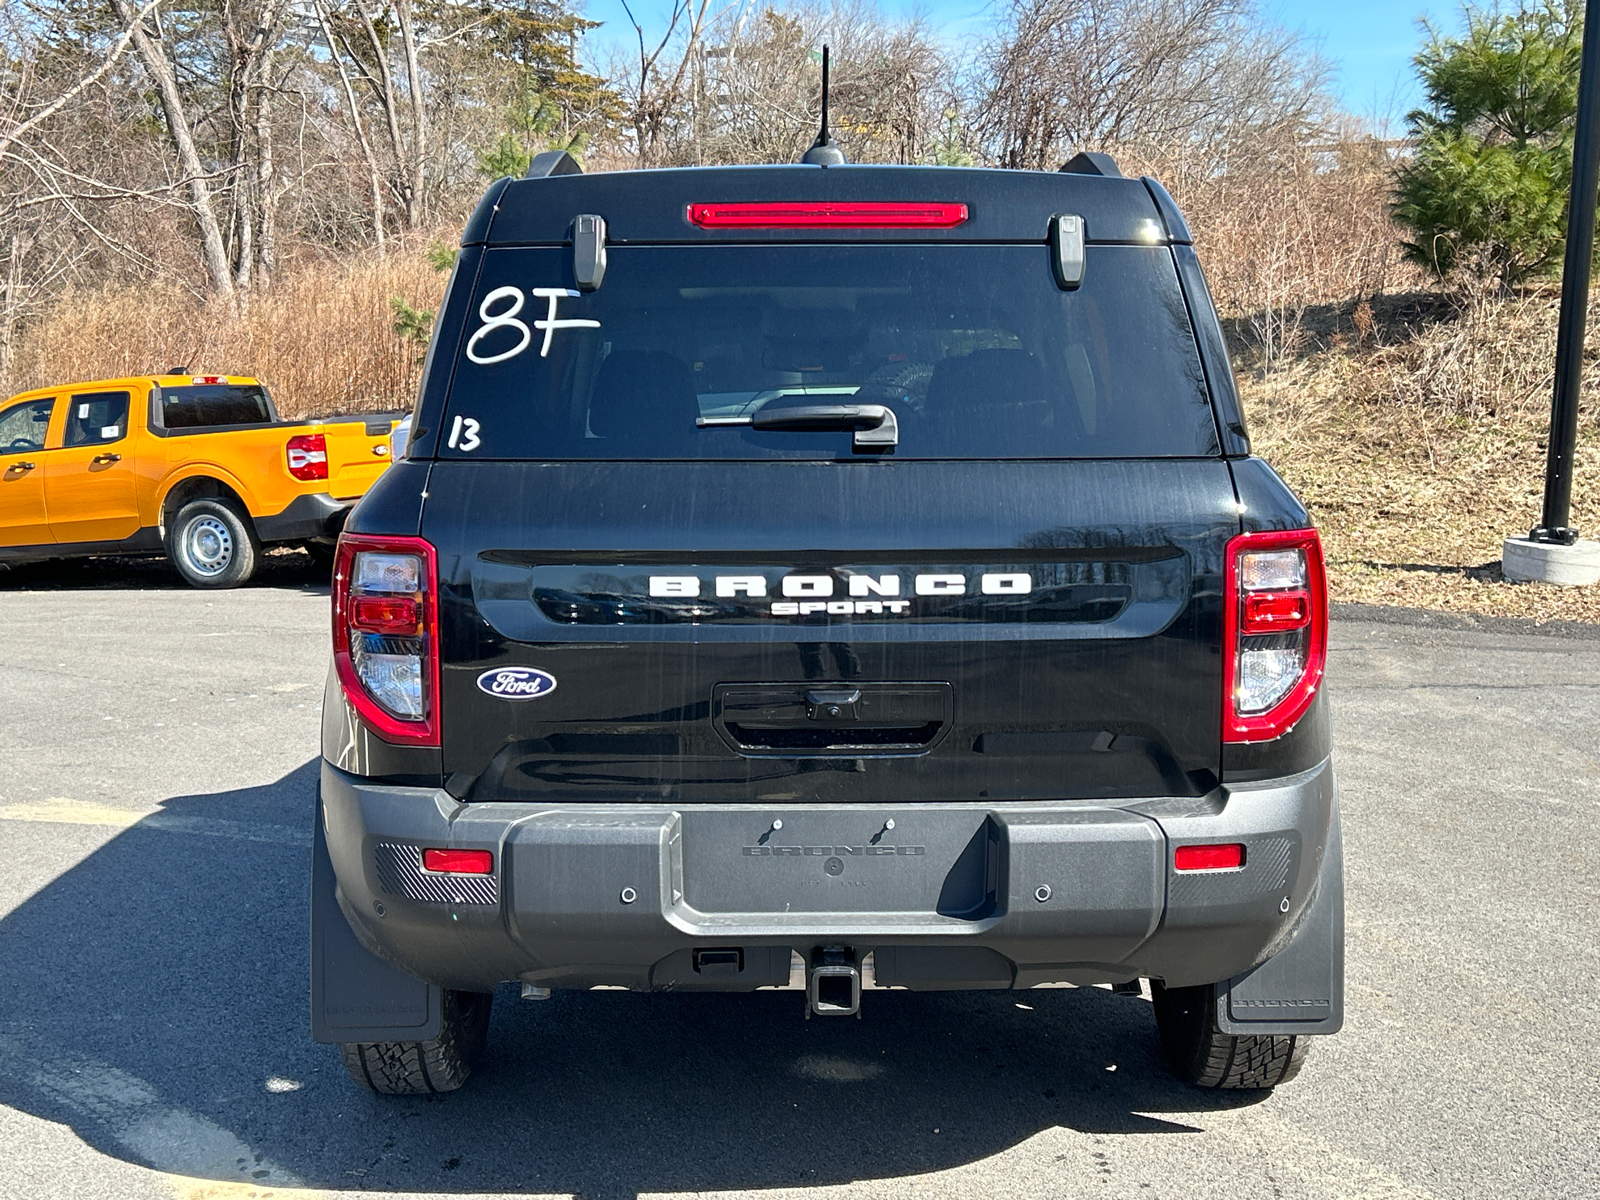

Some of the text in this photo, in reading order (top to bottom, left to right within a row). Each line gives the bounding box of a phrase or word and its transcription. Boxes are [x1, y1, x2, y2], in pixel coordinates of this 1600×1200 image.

[448, 415, 481, 452] 13
[648, 573, 1032, 597] BRONCO
[770, 600, 911, 616] SPORT
[491, 671, 542, 693] Ford
[742, 845, 926, 856] BRONCO
